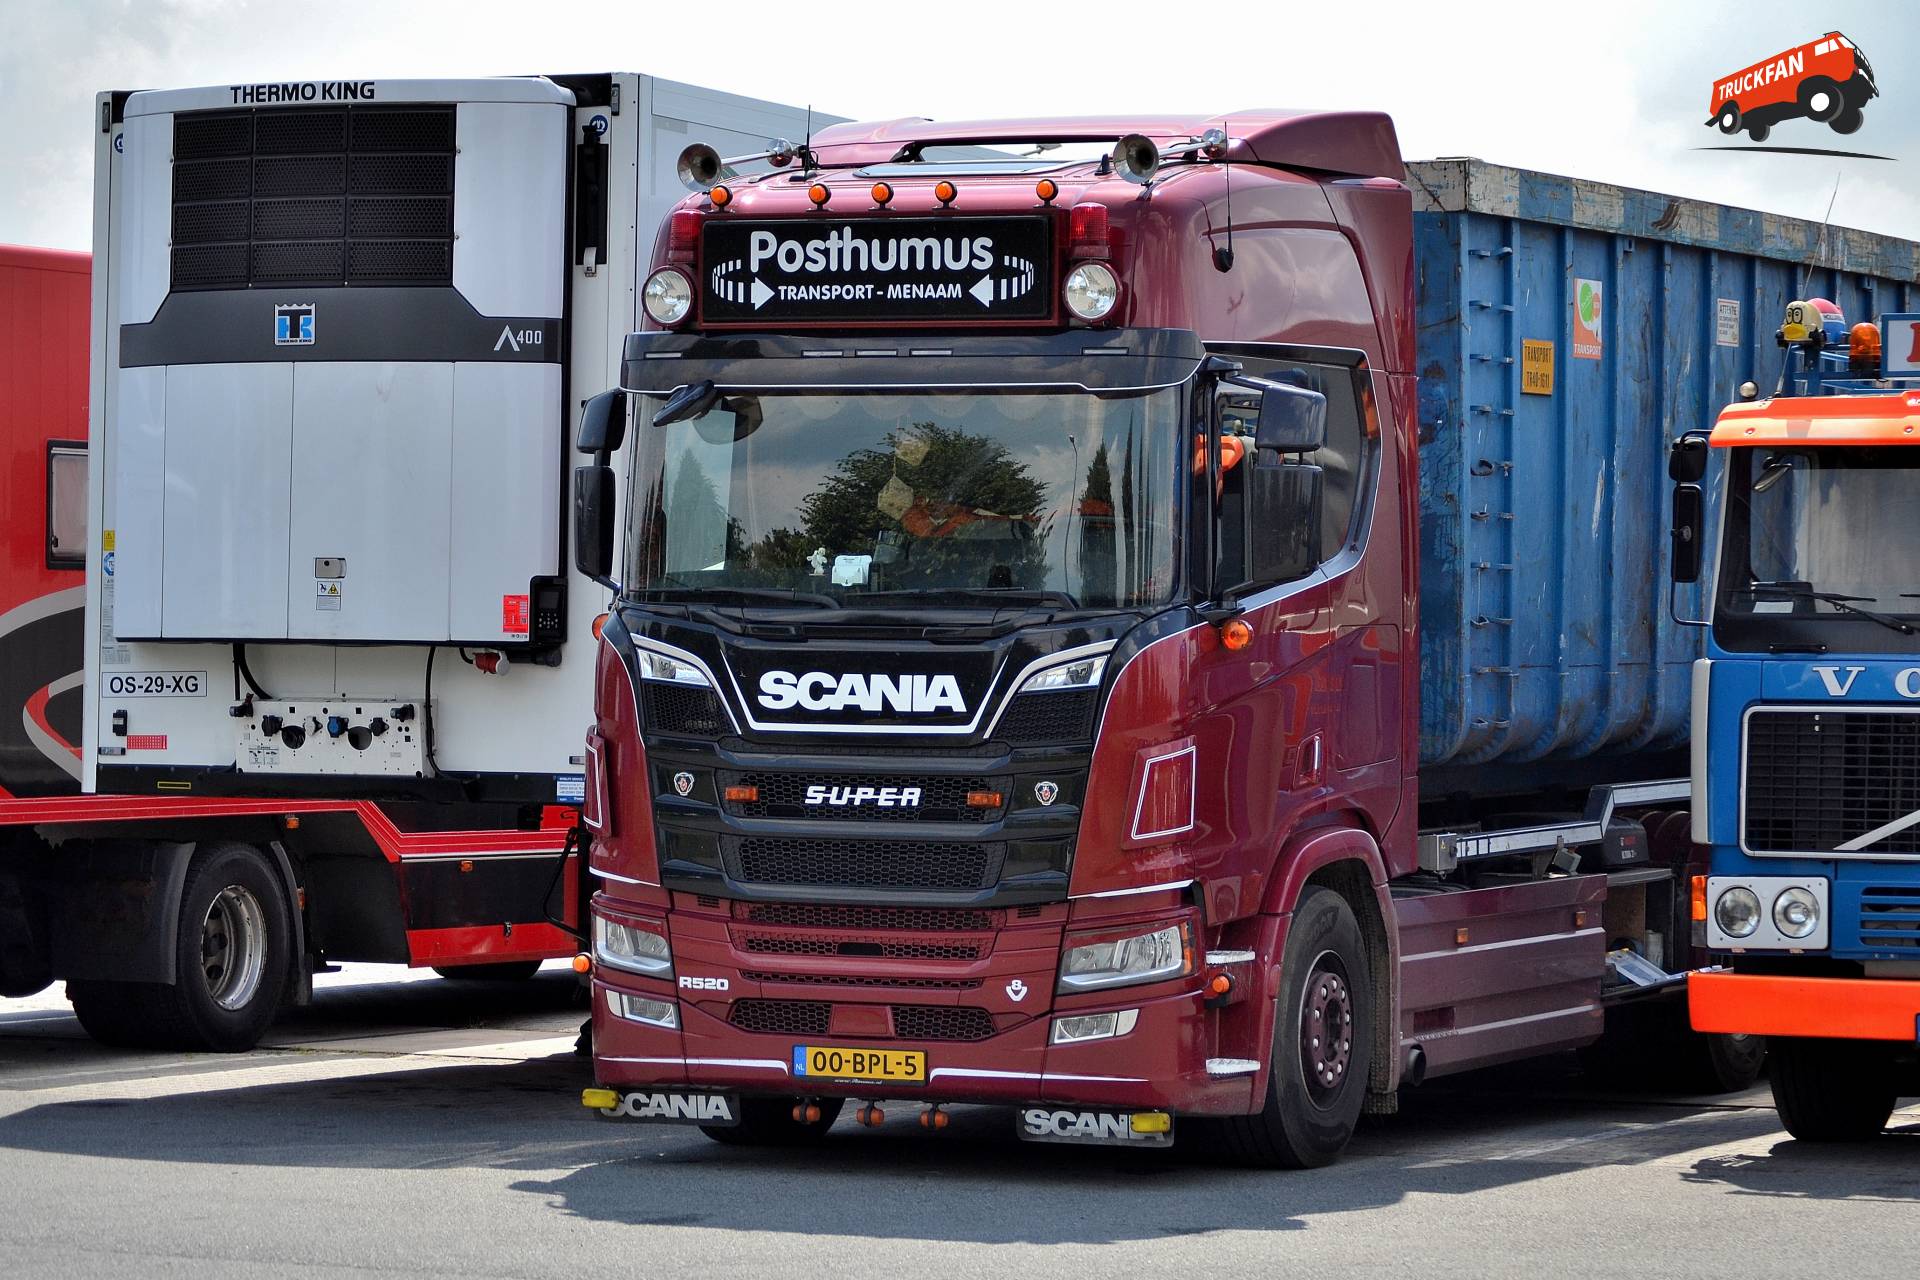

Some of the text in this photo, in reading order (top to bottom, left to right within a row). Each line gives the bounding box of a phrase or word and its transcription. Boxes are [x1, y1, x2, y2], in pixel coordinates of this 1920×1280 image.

[230, 81, 375, 104] THERMO KING
[750, 226, 994, 273] Posthumus
[778, 284, 874, 300] TRANSPORT
[887, 283, 962, 299] MENAAM
[1574, 343, 1602, 356] TRANSPORT
[110, 675, 199, 693] OS-29-XG
[757, 670, 967, 713] SCANIA
[805, 785, 921, 807] SUPER
[679, 976, 729, 991] R520
[795, 1063, 805, 1071] NL
[812, 1050, 917, 1076] 00-BPL-5
[1024, 1109, 1166, 1141] SCAN
